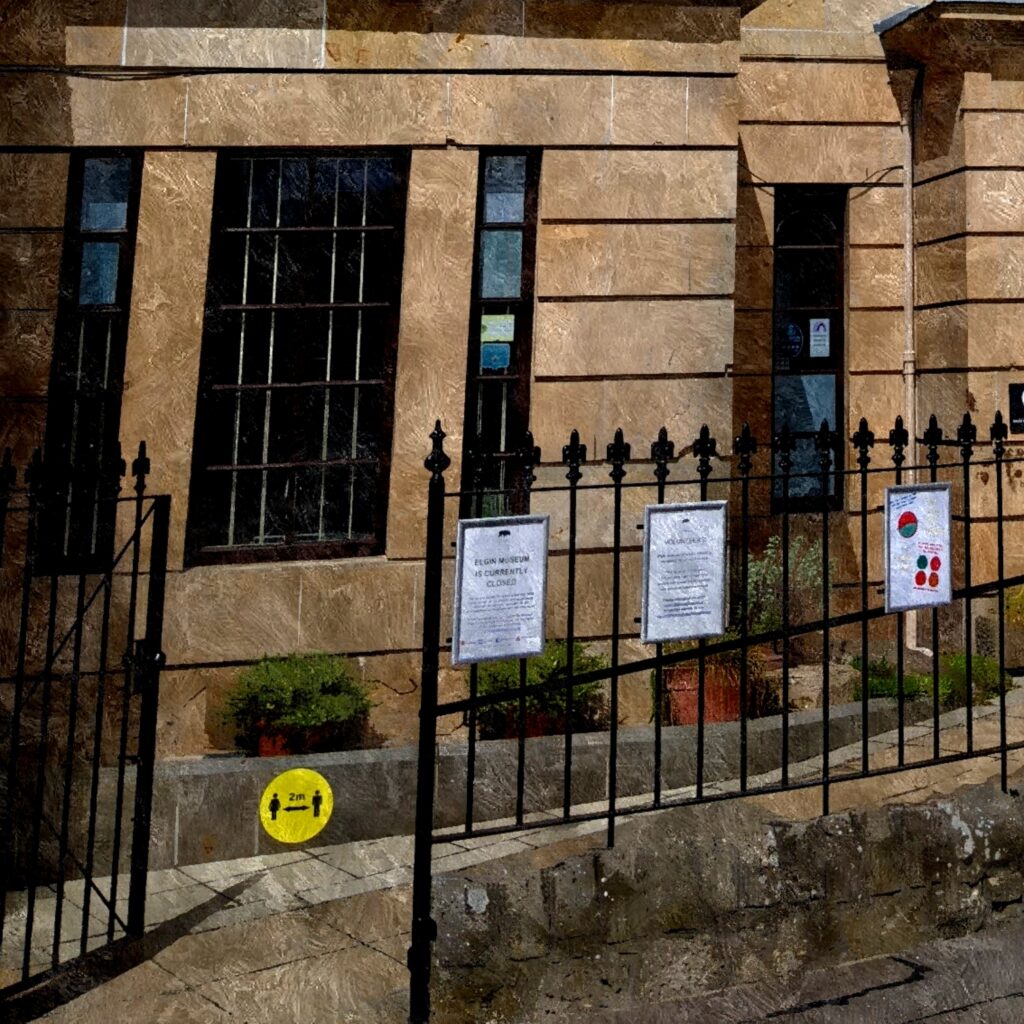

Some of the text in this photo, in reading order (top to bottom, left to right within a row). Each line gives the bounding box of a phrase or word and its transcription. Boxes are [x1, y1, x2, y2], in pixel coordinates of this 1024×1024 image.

[474, 555, 530, 566] ELGIN MUSEUM
[474, 567, 528, 578] IS CURRENTLY
[486, 578, 517, 588] CLOSED
[288, 792, 305, 801] 2m
